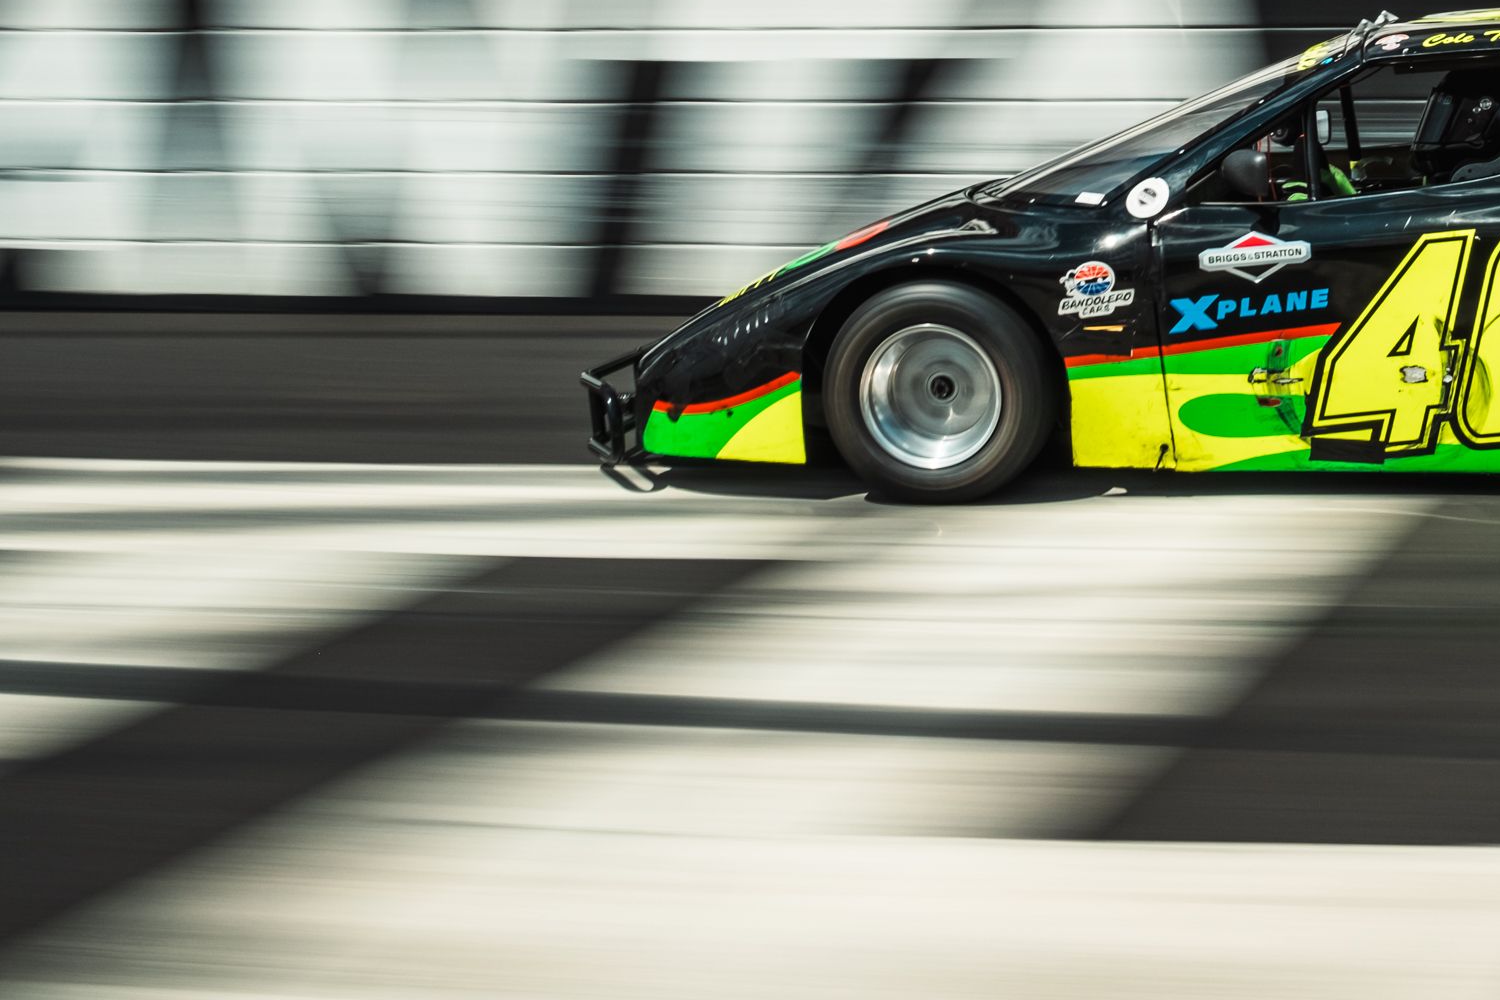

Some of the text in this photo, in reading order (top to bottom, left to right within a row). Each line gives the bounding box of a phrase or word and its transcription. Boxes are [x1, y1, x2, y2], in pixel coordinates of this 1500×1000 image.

[1422, 33, 1475, 48] Cole
[1061, 292, 1132, 310] BANDOLERO
[1168, 288, 1330, 334] XPLANE
